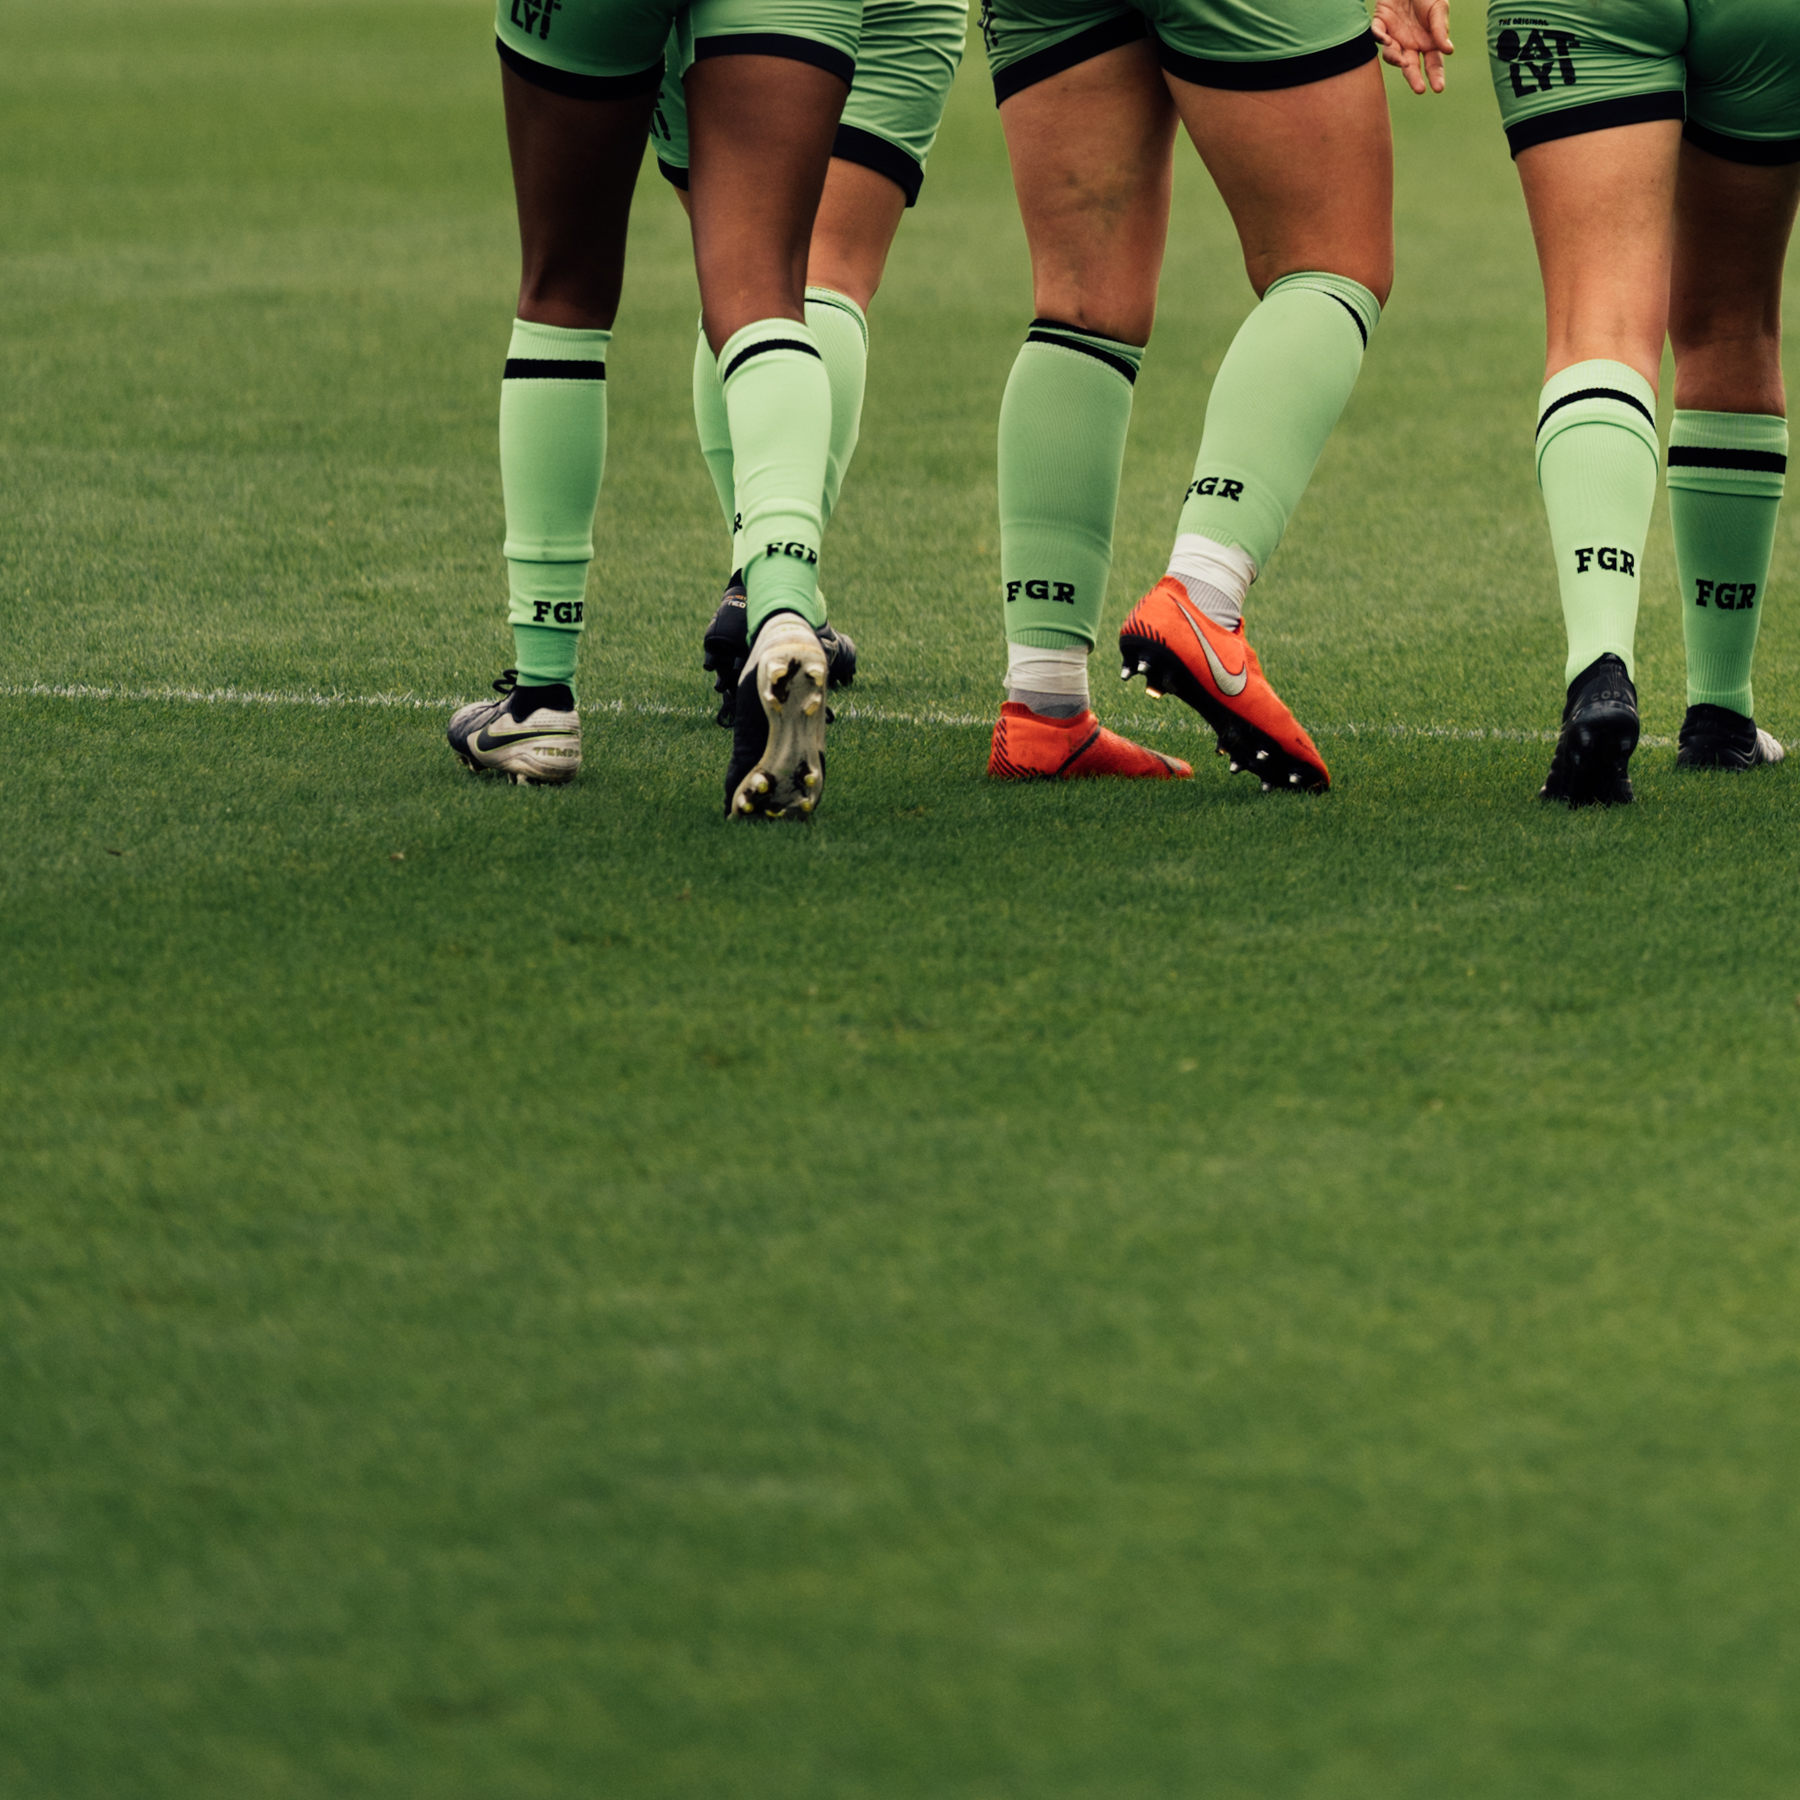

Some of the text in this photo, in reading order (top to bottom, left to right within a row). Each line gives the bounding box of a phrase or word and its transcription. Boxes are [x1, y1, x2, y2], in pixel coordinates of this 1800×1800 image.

[1512, 17, 1550, 27] ORIGINAL
[1509, 57, 1577, 98] LY!
[1183, 476, 1245, 503] FGR
[765, 541, 818, 565] FGR
[1574, 546, 1635, 577] FGR
[1005, 578, 1076, 605] FGR
[1694, 578, 1757, 610] FGR
[532, 600, 584, 624] FGR
